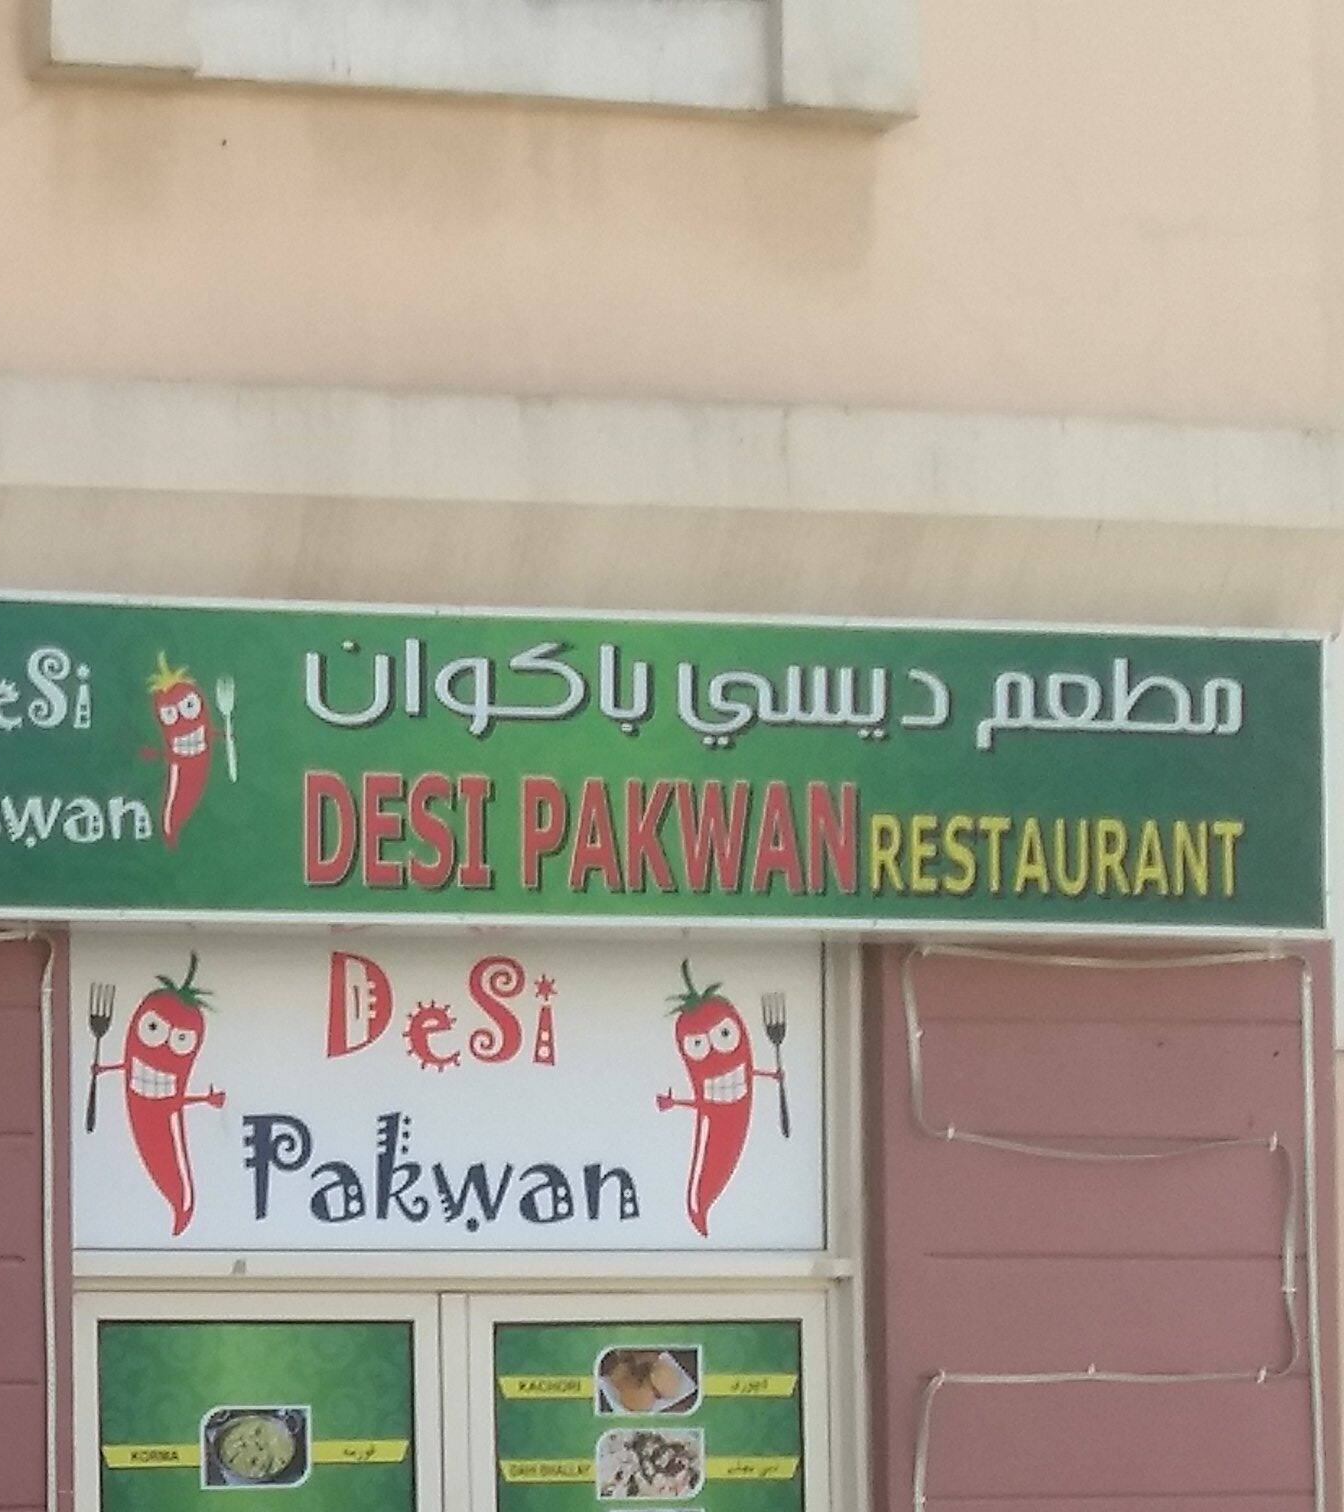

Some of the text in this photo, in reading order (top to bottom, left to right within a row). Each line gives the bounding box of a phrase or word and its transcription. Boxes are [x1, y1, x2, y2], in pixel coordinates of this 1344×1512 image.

[305, 638, 1244, 751] مطعم ديسي باكوان
[303, 770, 1244, 897] DESI PAKWAN RESTAURANT
[241, 1112, 641, 1233] Pakwan
